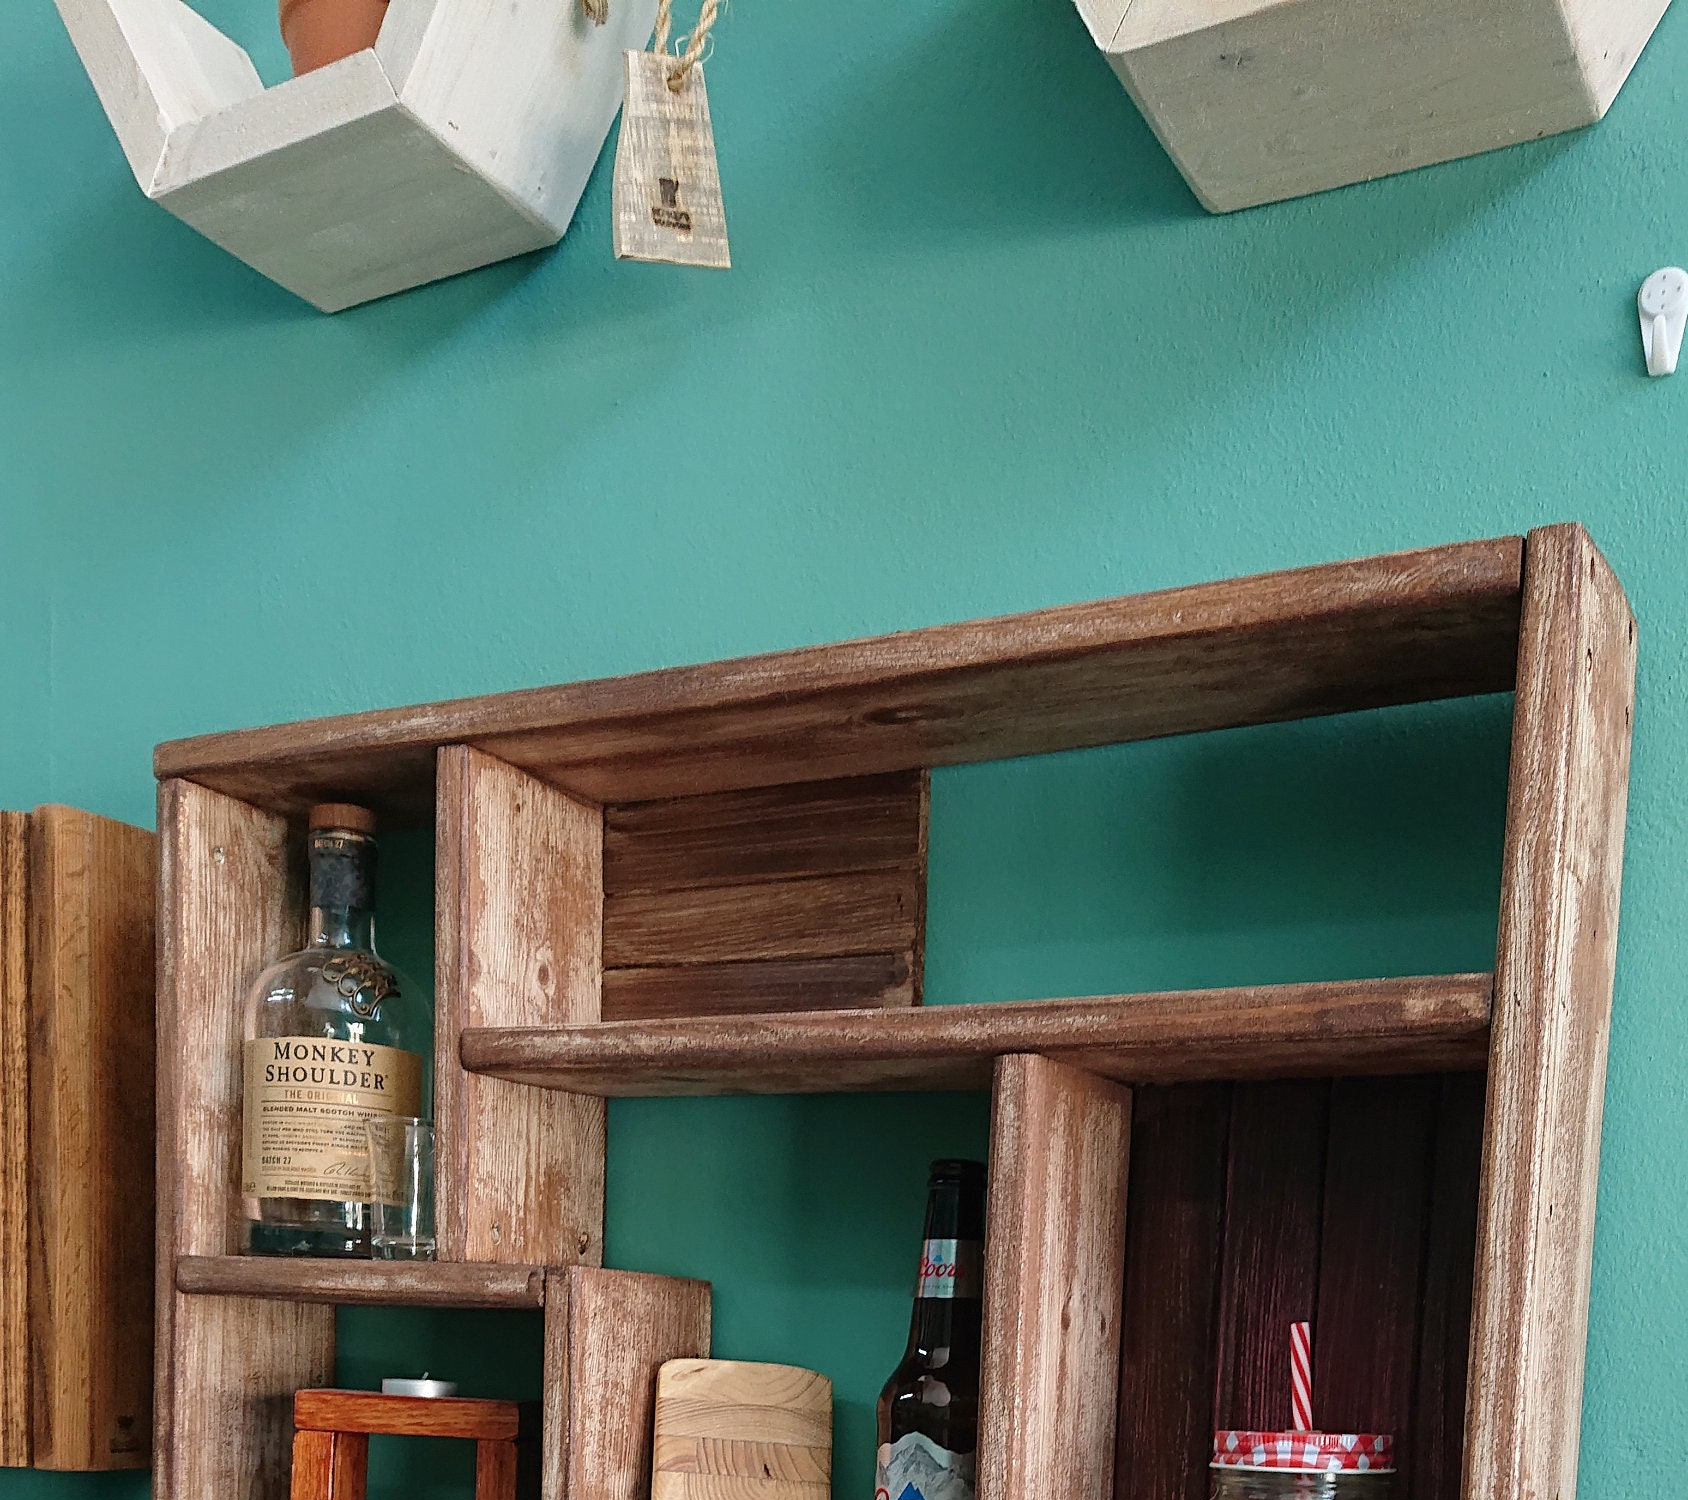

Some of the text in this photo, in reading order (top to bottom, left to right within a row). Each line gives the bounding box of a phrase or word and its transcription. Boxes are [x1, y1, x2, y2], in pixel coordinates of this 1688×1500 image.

[274, 1041, 375, 1067] MONKEY
[265, 1064, 385, 1090] SHOULDER
[284, 1089, 301, 1099] THE
[262, 1105, 294, 1113] BLENDED
[296, 1106, 317, 1114] MALT
[320, 1107, 355, 1117] SCOTCH
[261, 1156, 281, 1165] BATCH
